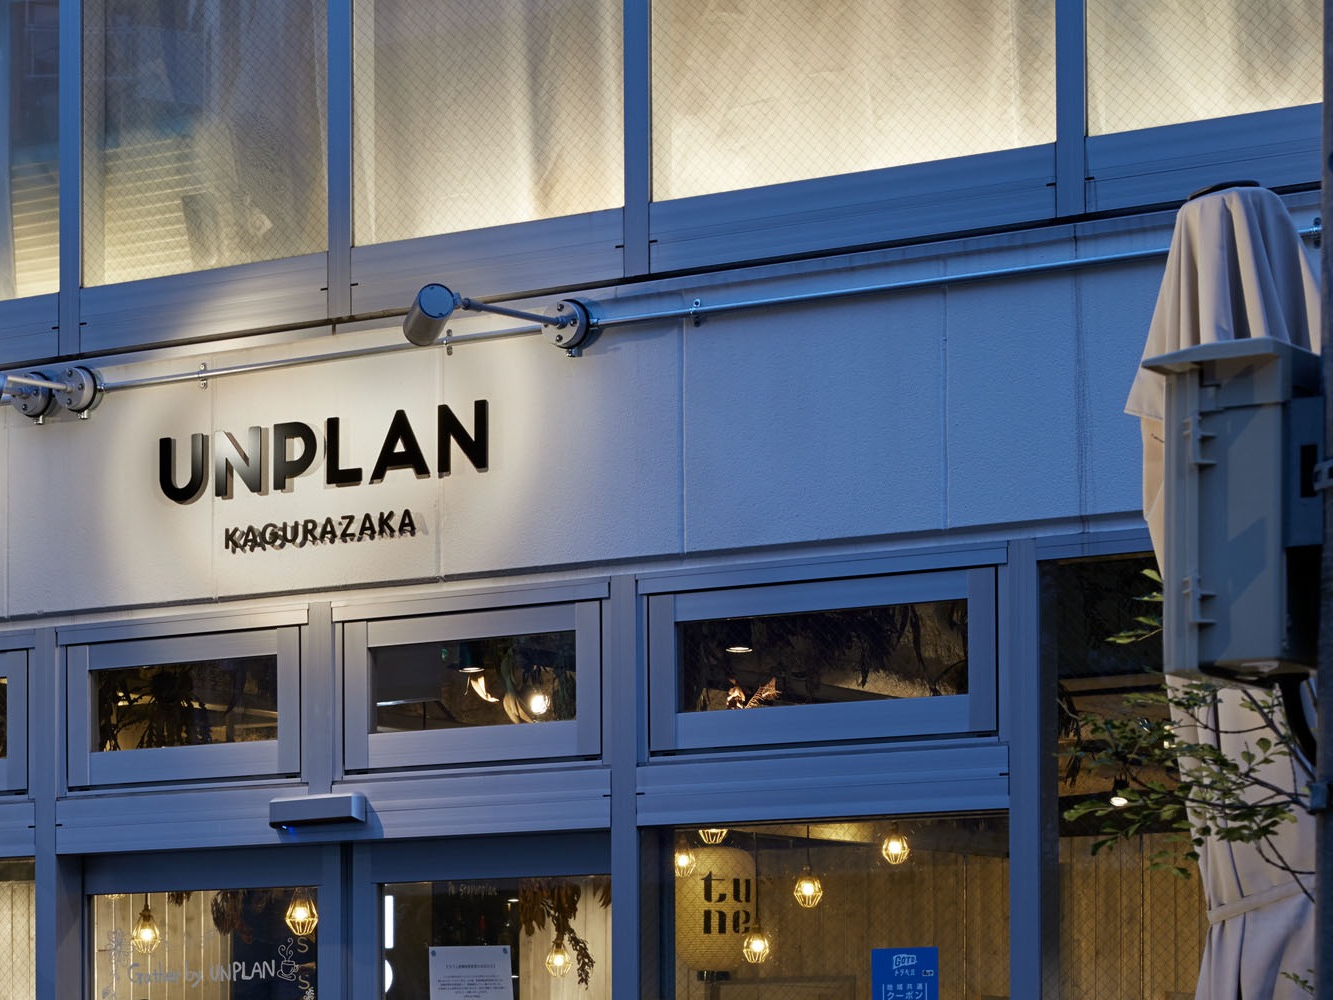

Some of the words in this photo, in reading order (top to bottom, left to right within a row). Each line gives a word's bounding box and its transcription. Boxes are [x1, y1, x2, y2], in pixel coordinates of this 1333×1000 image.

[158, 399, 489, 504] UNPLAN
[224, 508, 417, 552] KAGURAZAKA
[209, 960, 275, 982] UNPLAN
[886, 991, 924, 1000] クーポン
